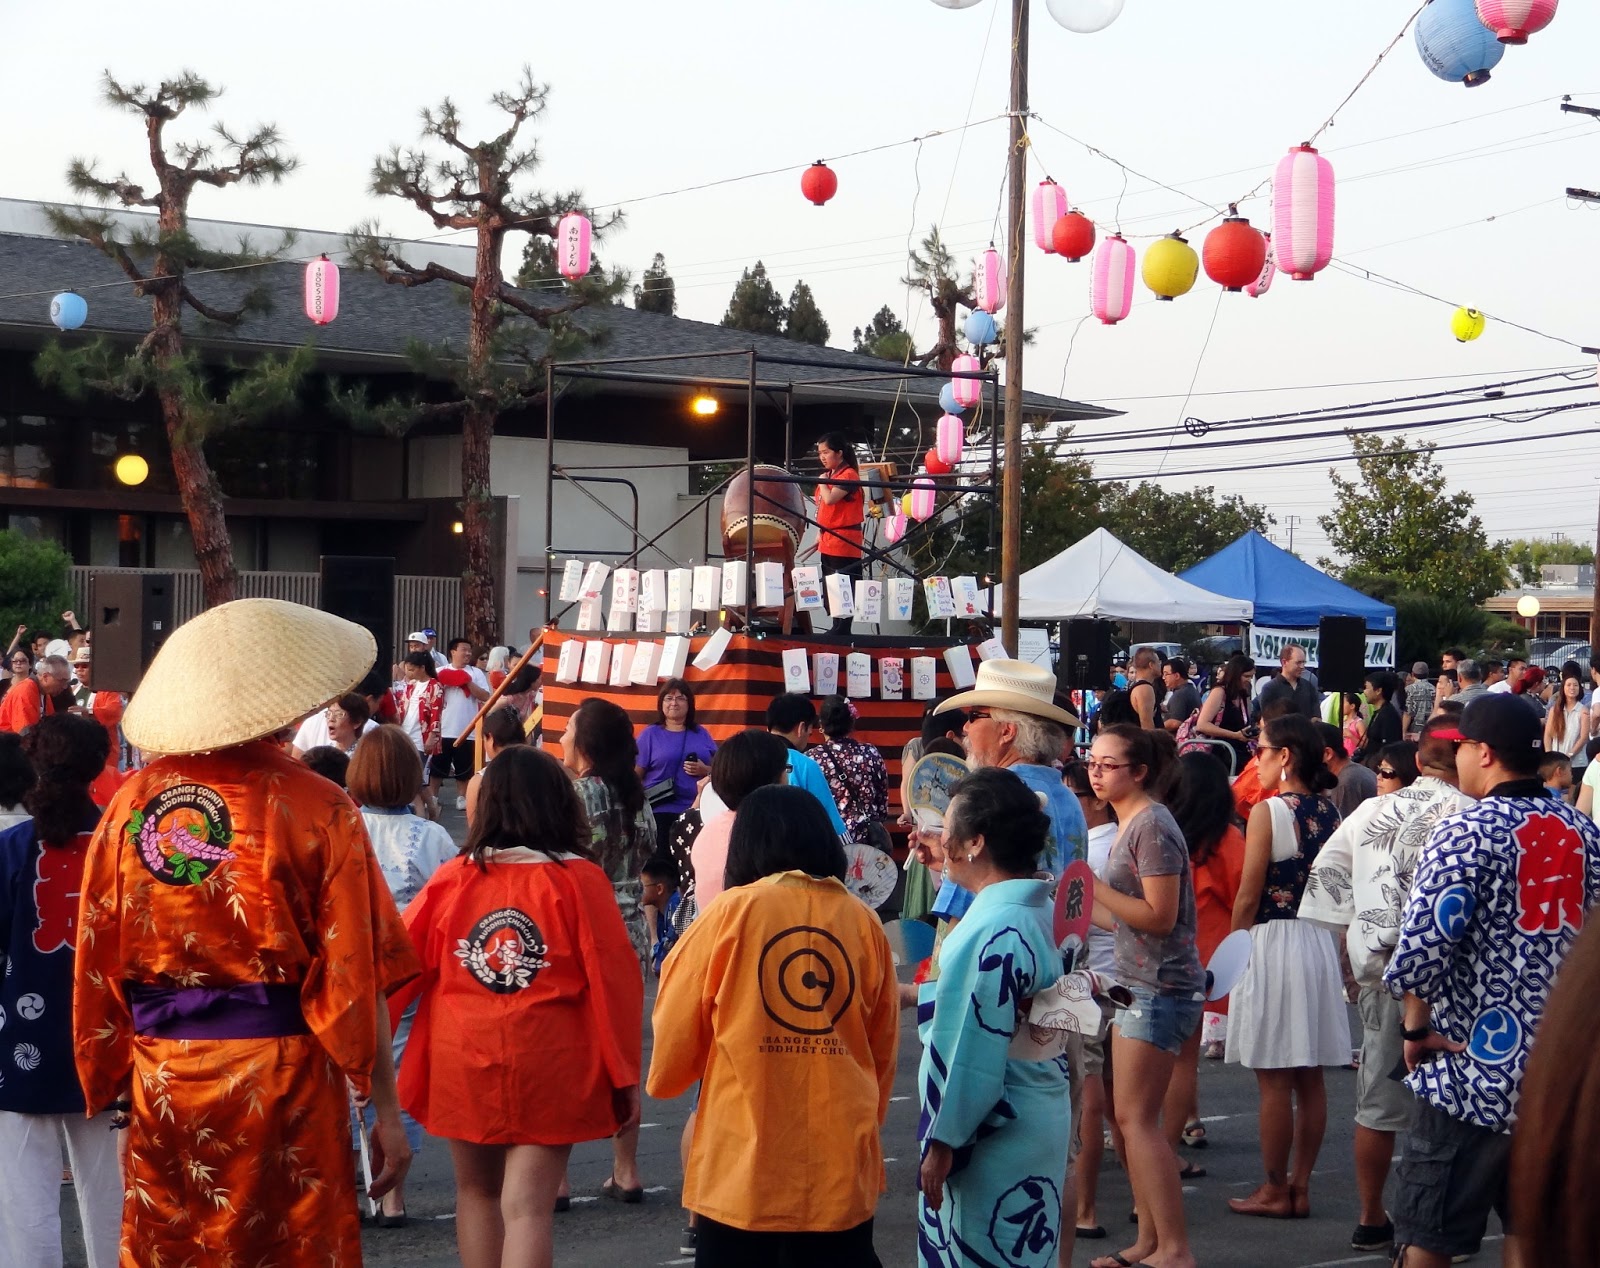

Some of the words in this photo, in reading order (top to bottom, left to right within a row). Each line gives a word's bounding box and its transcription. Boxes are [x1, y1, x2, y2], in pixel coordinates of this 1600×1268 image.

[160, 785, 196, 802] ORANGE
[197, 786, 225, 808] COUNTY
[155, 794, 197, 816] BUDDHIST
[196, 796, 222, 823] CHURCH
[478, 918, 508, 940] BUDDHIS
[507, 917, 532, 939] CHURCH
[762, 1035, 811, 1045] RANGE
[815, 1037, 843, 1046] COU
[820, 1047, 849, 1056] CHU
